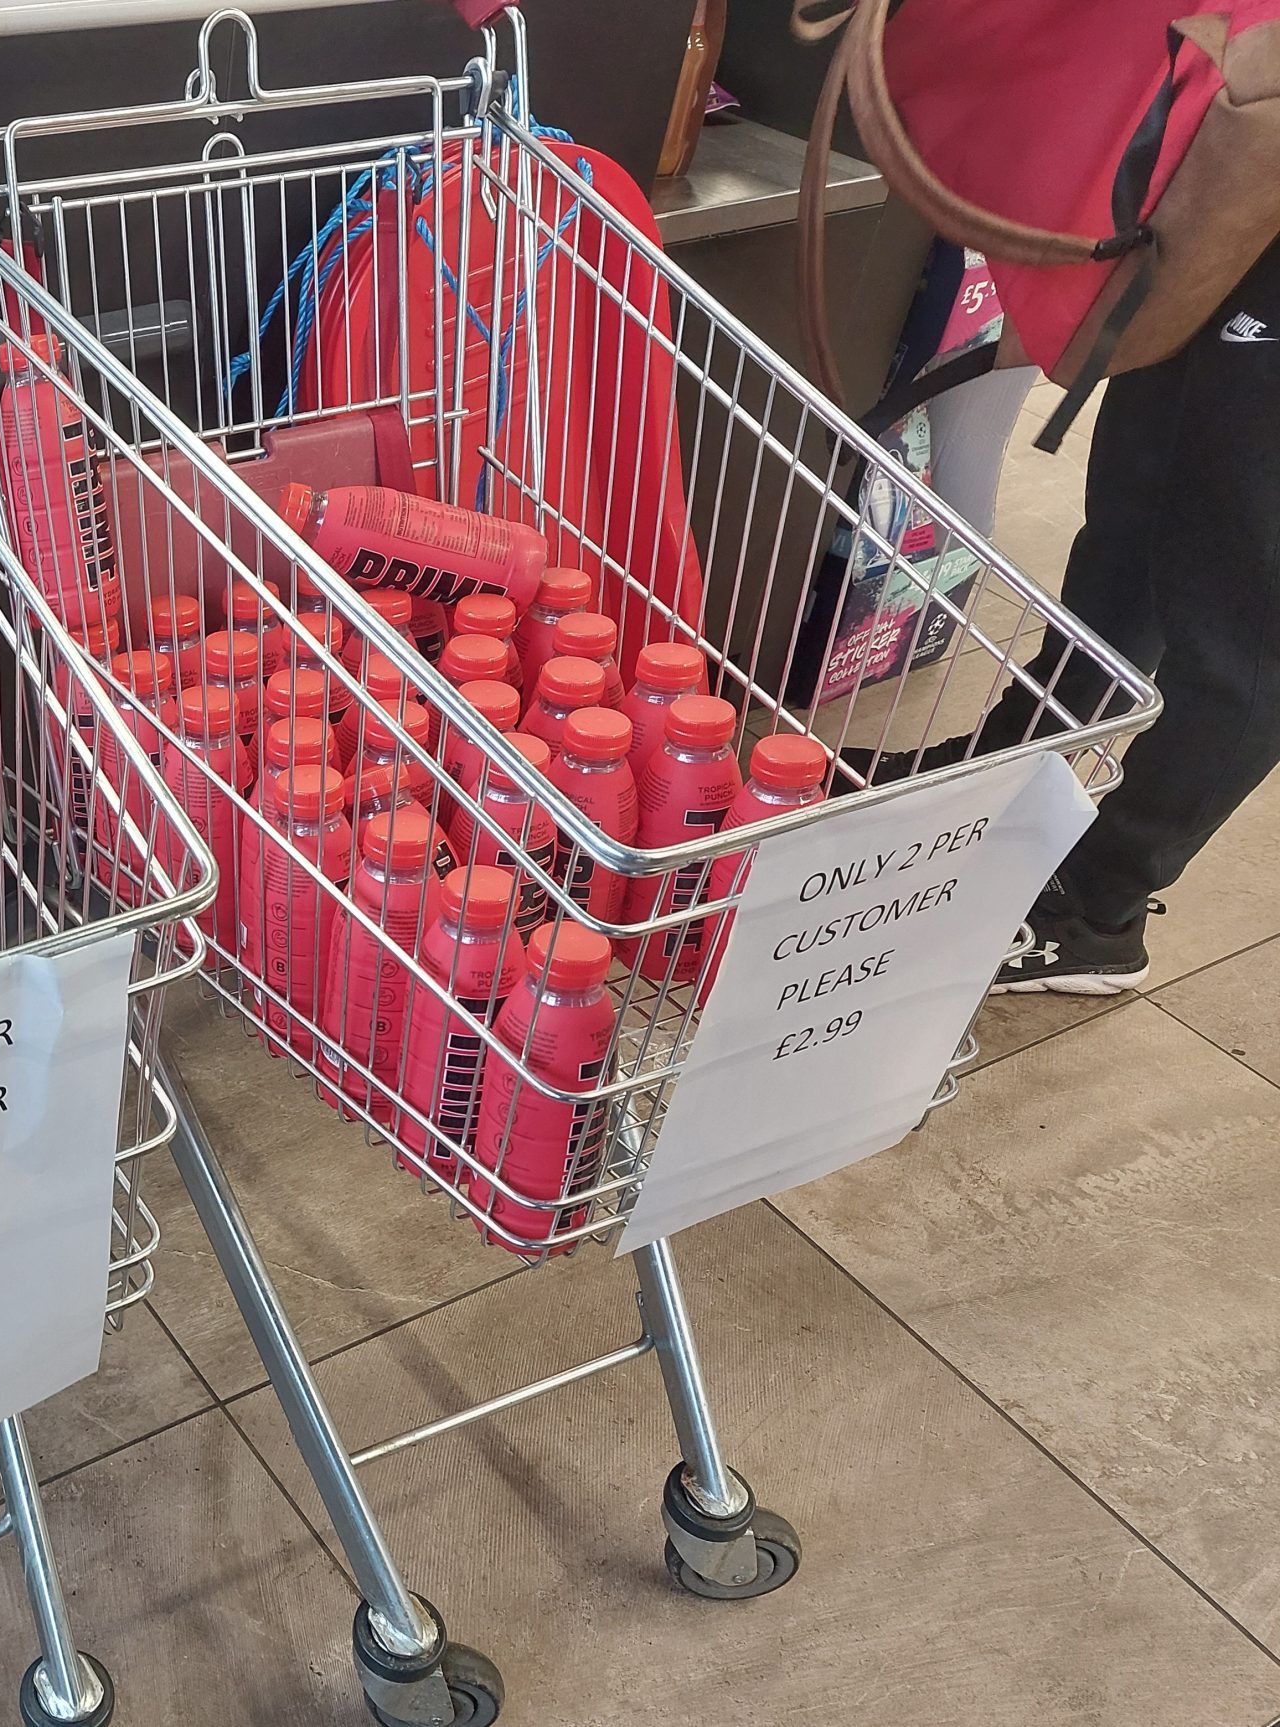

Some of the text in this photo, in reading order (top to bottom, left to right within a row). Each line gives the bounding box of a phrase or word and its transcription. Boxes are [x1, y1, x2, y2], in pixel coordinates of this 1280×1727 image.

[698, 781, 736, 795] TROPICAL
[705, 788, 734, 802] PUNCH
[798, 816, 990, 903] ONLY 2 PER
[772, 878, 959, 962] CUSTOMER
[775, 948, 896, 1011] PLEASE
[772, 1008, 864, 1062] £2.99
